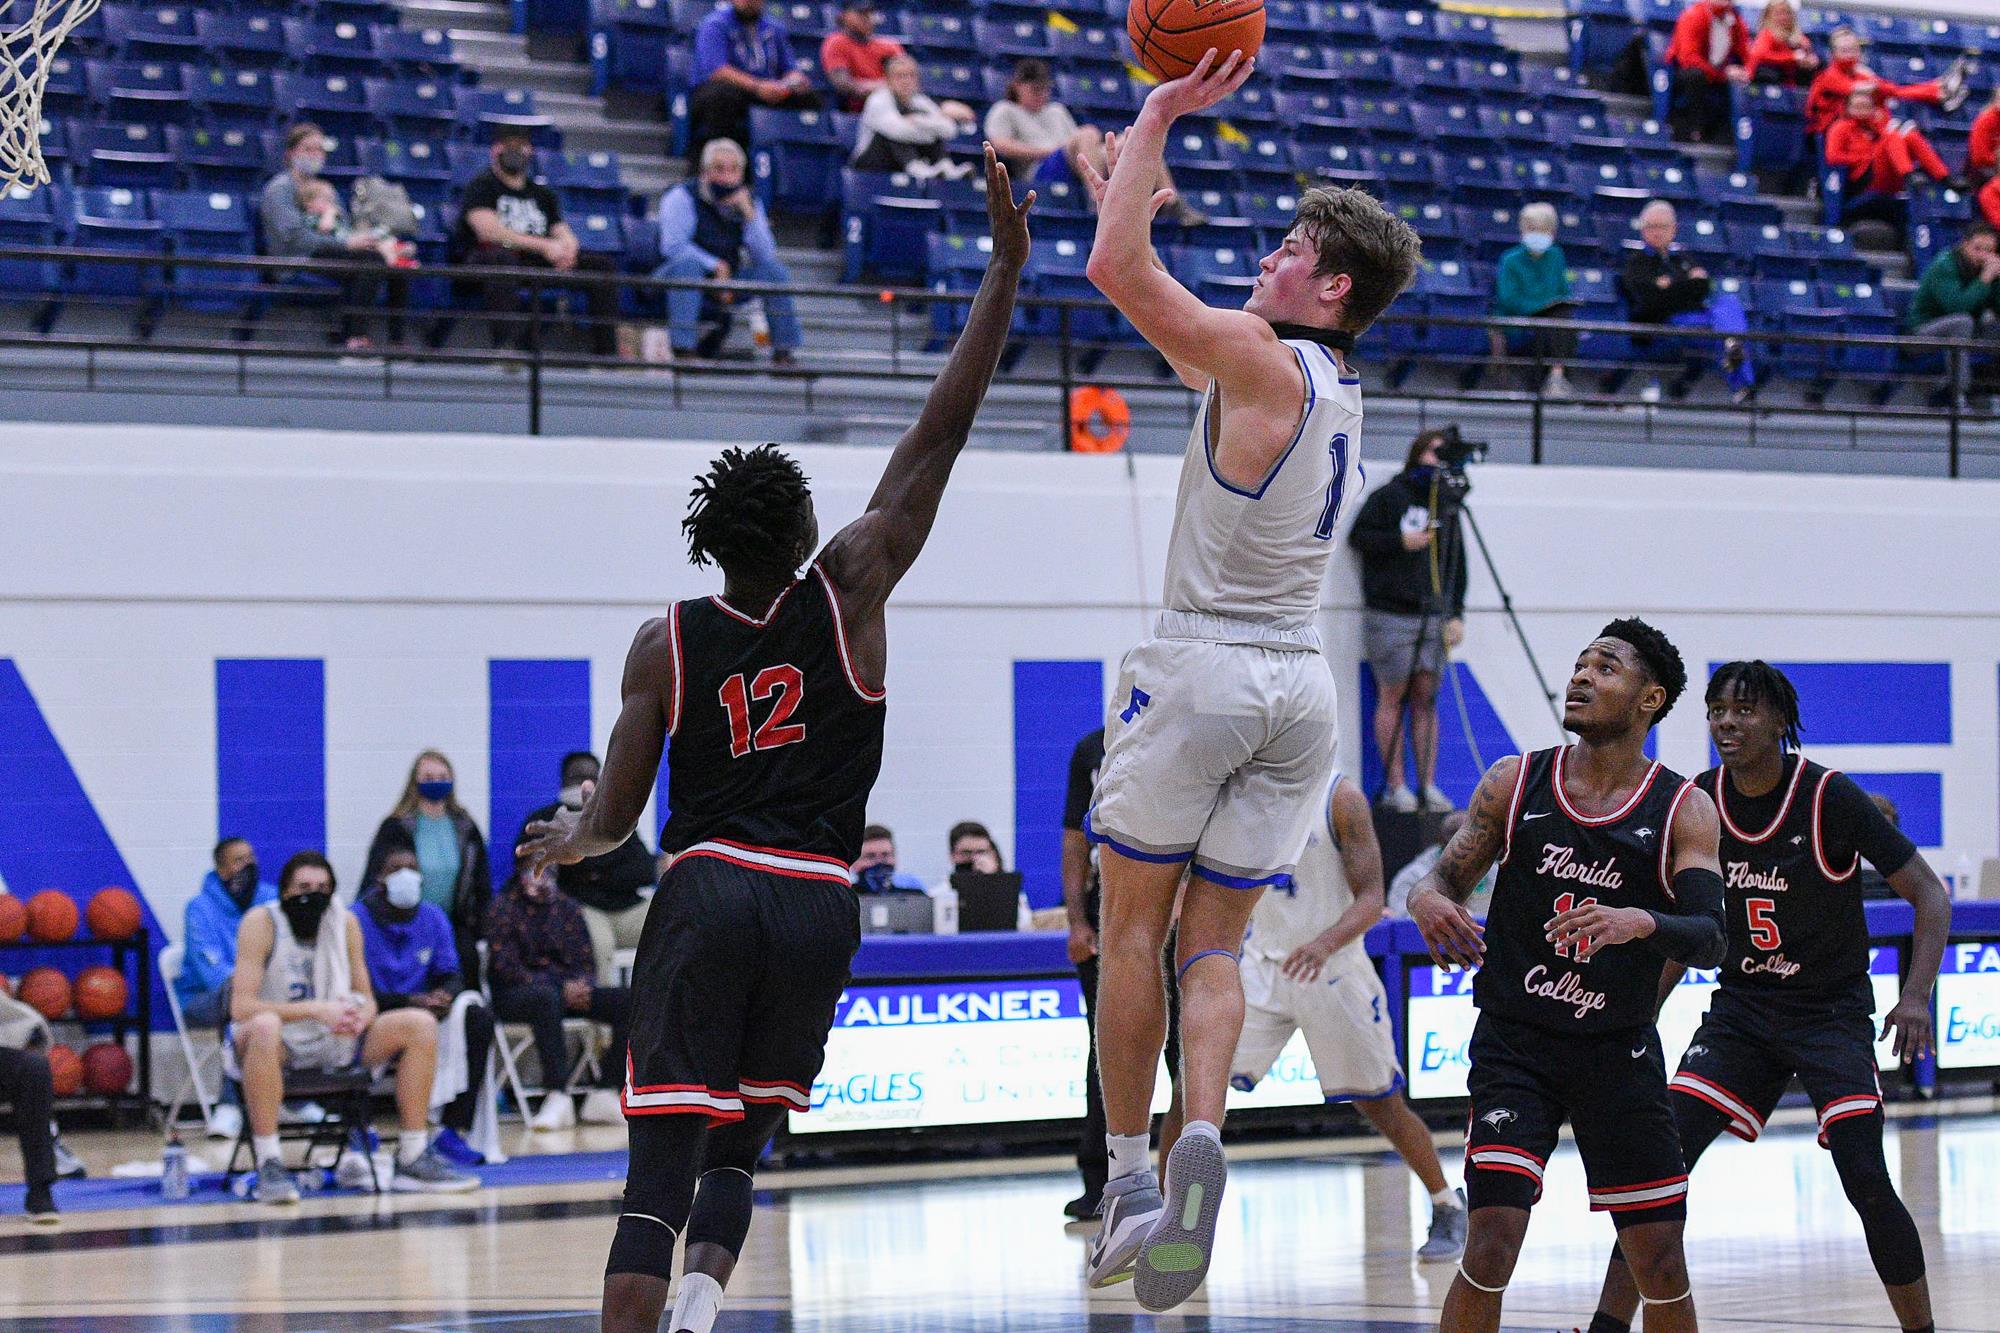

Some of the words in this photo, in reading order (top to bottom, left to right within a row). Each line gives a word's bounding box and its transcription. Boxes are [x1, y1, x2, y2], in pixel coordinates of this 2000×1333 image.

[1313, 432, 1348, 541] 1
[718, 663, 806, 759] 12
[1536, 843, 1623, 889] Florida
[1726, 861, 1788, 892] Florida
[1745, 898, 1782, 951] 5
[1524, 964, 1606, 1019] College
